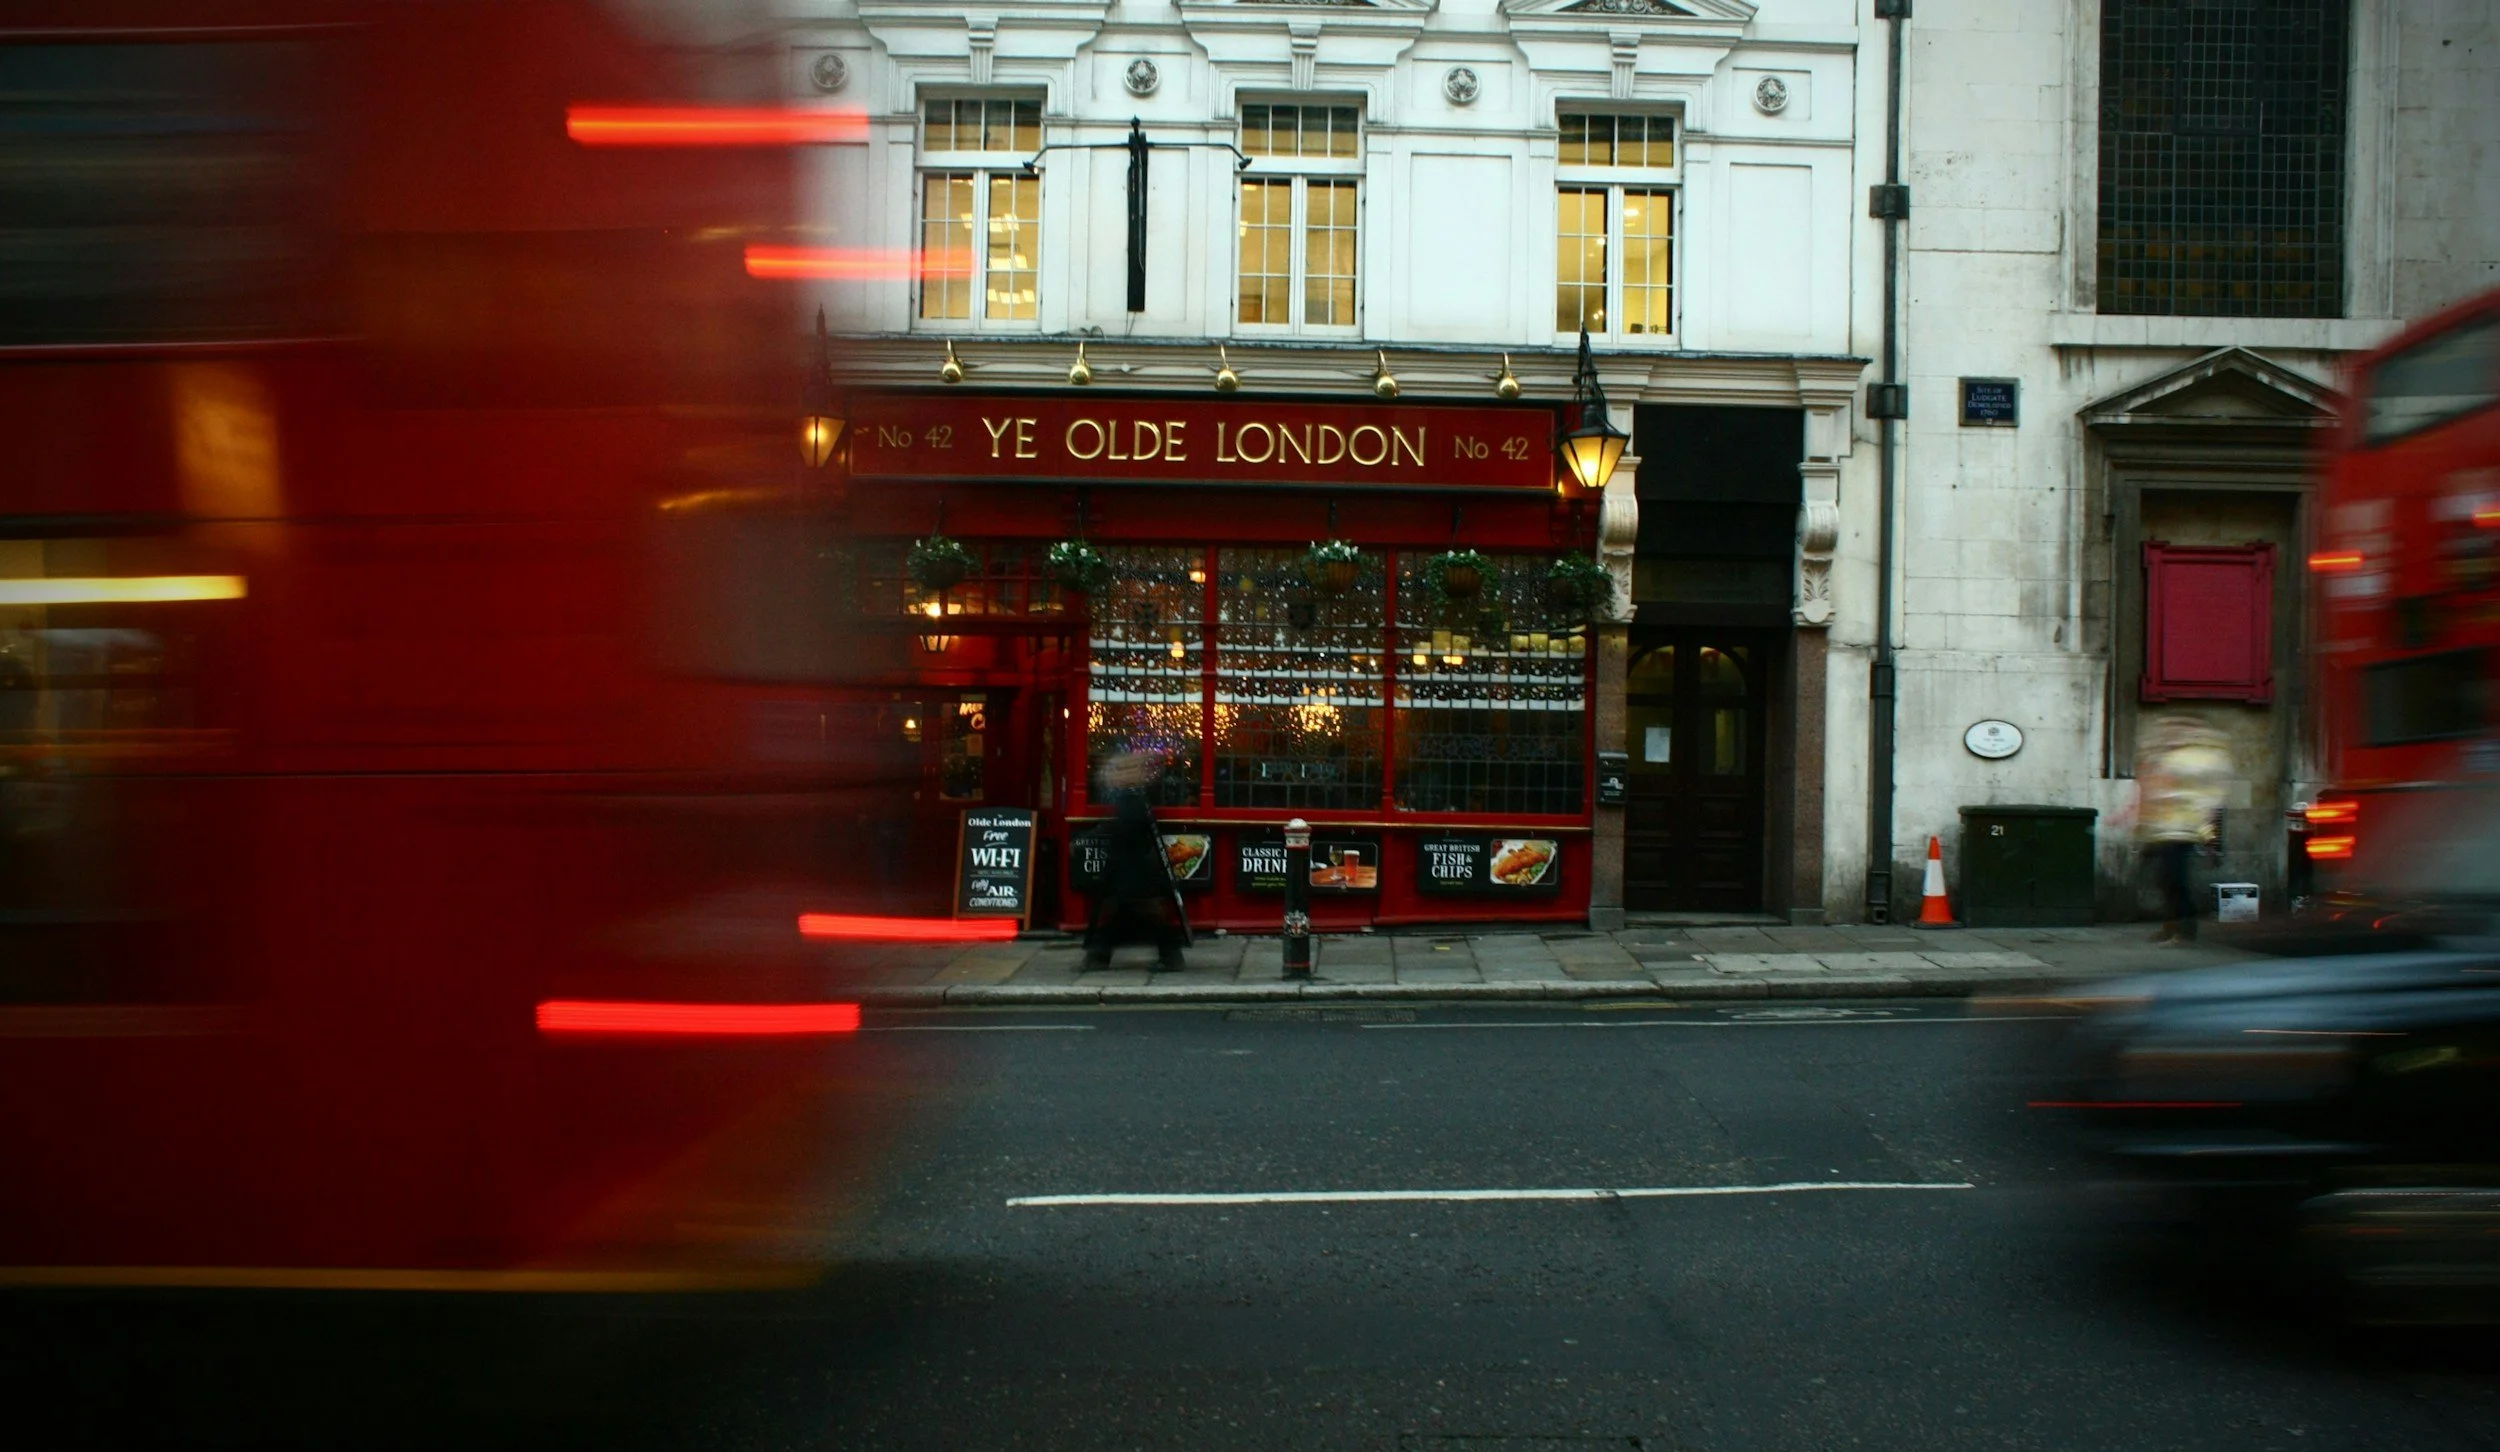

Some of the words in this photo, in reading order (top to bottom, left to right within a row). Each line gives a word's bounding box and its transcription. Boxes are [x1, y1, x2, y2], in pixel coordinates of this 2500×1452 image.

[1971, 393, 2006, 401] LUDGATE
[878, 425, 912, 448] No
[924, 425, 952, 448] 42
[981, 417, 1038, 458] YE
[1066, 419, 1188, 461] OLDE
[1217, 422, 1426, 466] LONDON
[1454, 436, 1489, 460] No
[1501, 437, 1529, 460] 42
[967, 818, 991, 827] Olde
[993, 818, 1032, 828] London
[983, 830, 1009, 841] Free
[1991, 824, 2004, 836] 21
[1084, 847, 1108, 860] FIS
[1242, 847, 1282, 858] CLASSIC
[1423, 843, 1448, 852] GREAT
[1449, 844, 1481, 853] BRITISH
[971, 847, 1022, 868] WI-FI
[1432, 852, 1465, 865] FISH
[1431, 865, 1473, 879] CHIPS
